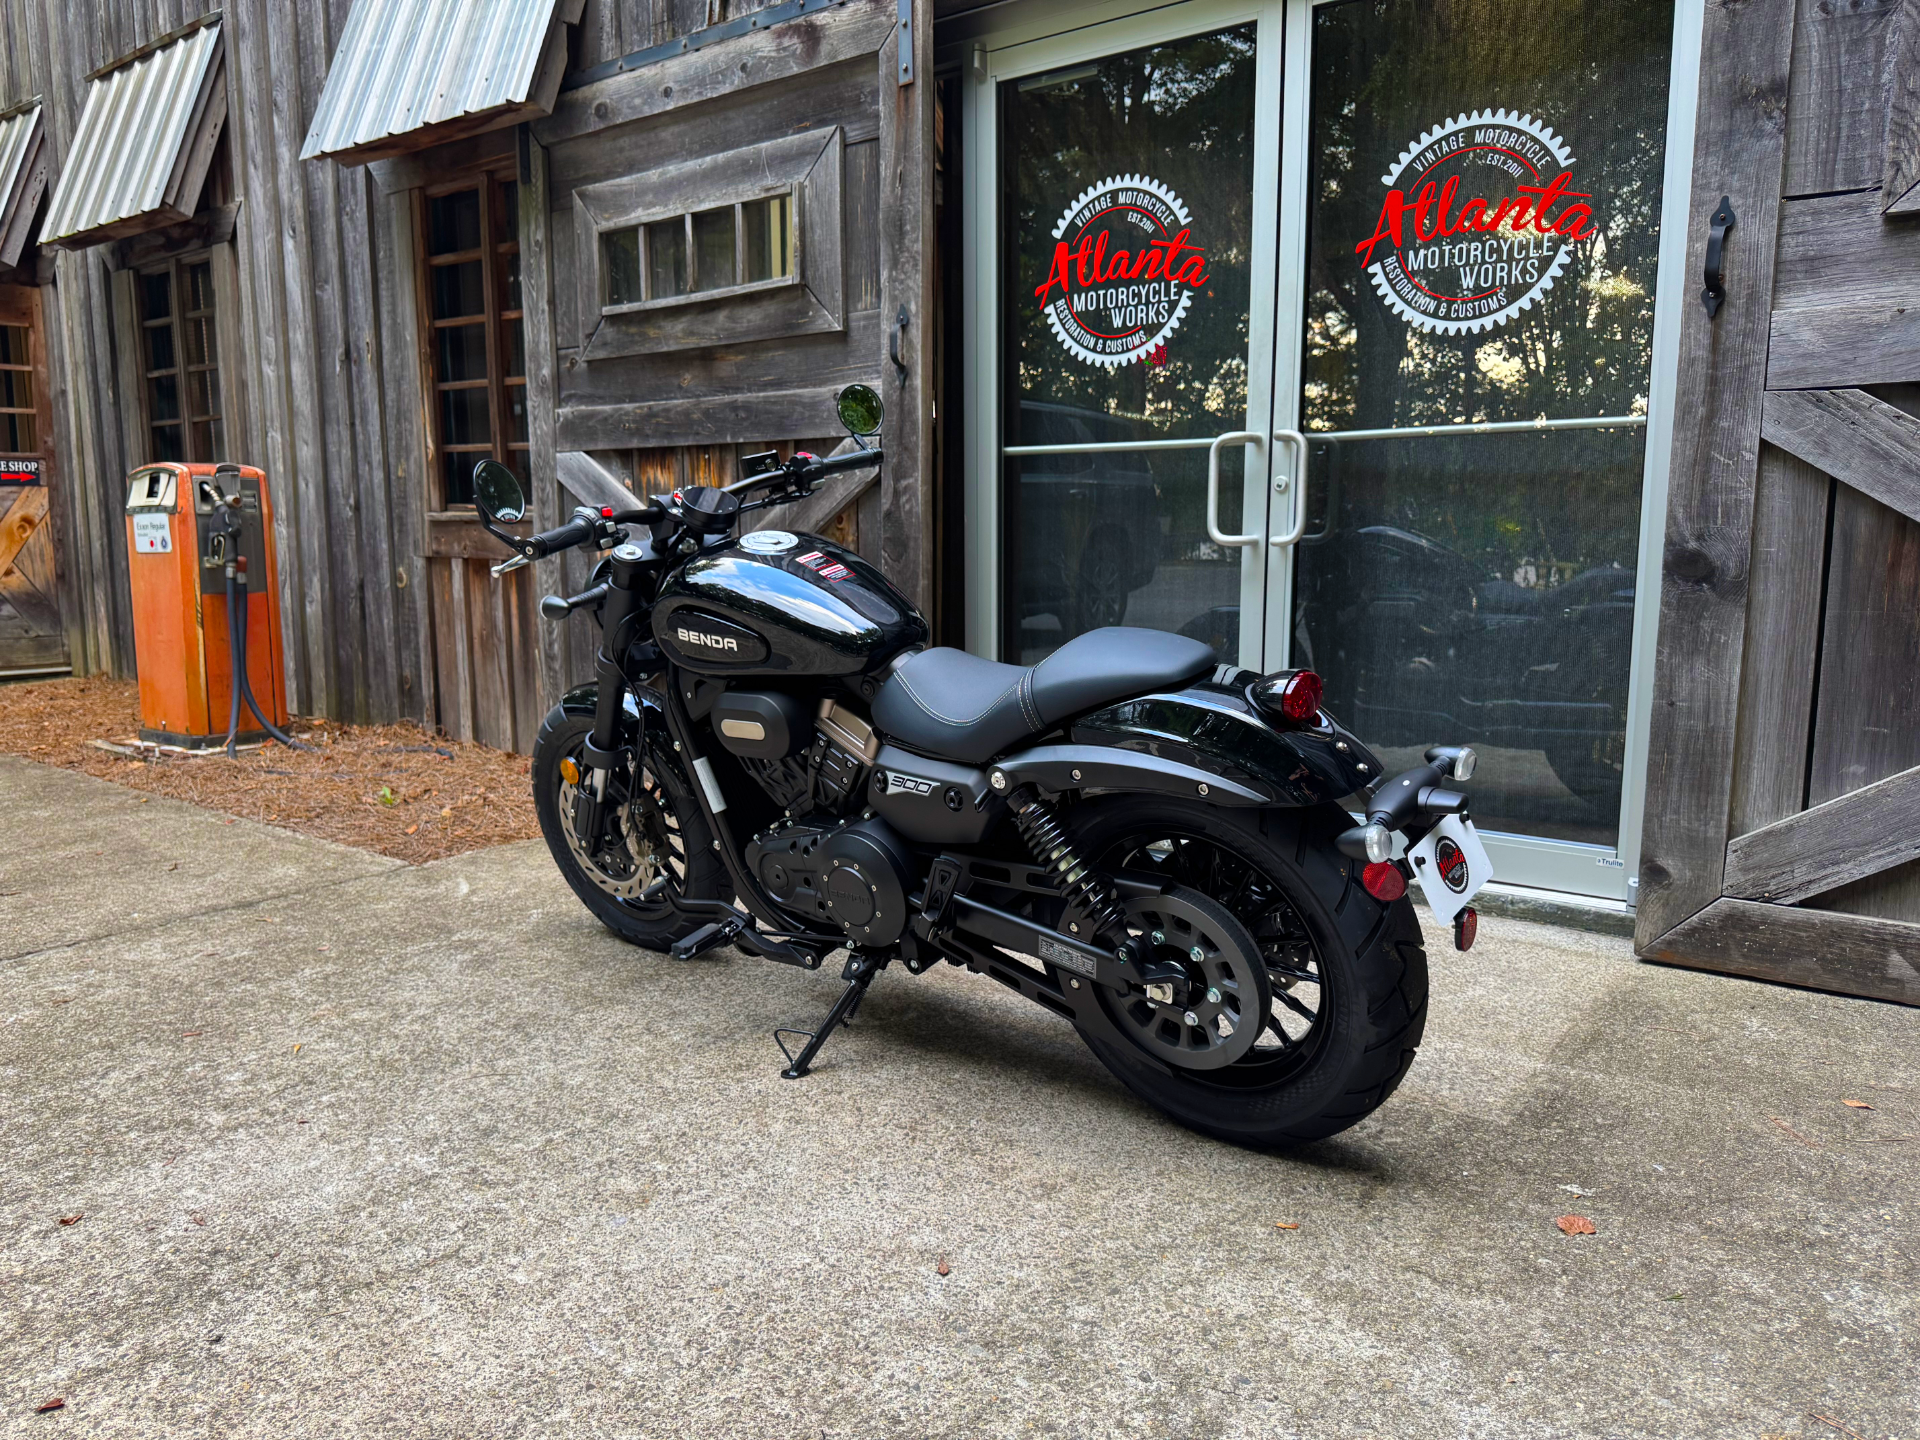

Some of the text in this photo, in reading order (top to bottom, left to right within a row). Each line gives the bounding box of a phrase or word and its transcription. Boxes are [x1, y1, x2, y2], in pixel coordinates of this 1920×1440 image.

[1412, 128, 1551, 172] VINTAGE MOTORCYCLE
[1074, 190, 1175, 228] VINTAGE MOTORCYCLE
[1355, 171, 1598, 269] Atlanta
[1034, 228, 1210, 311] Atlanta
[1407, 233, 1554, 271] MOTORCYCLE
[1383, 255, 1507, 318] RESTORATION & CUSTOMS
[1459, 258, 1539, 290] WORKS
[1073, 280, 1180, 313] MOTORCYCLE
[1111, 302, 1169, 329] WORKS
[1055, 298, 1147, 353] RESTORATION & CUSTOMS
[8, 461, 38, 472] SHOP
[677, 627, 738, 652] BENDA
[890, 775, 933, 794] 300
